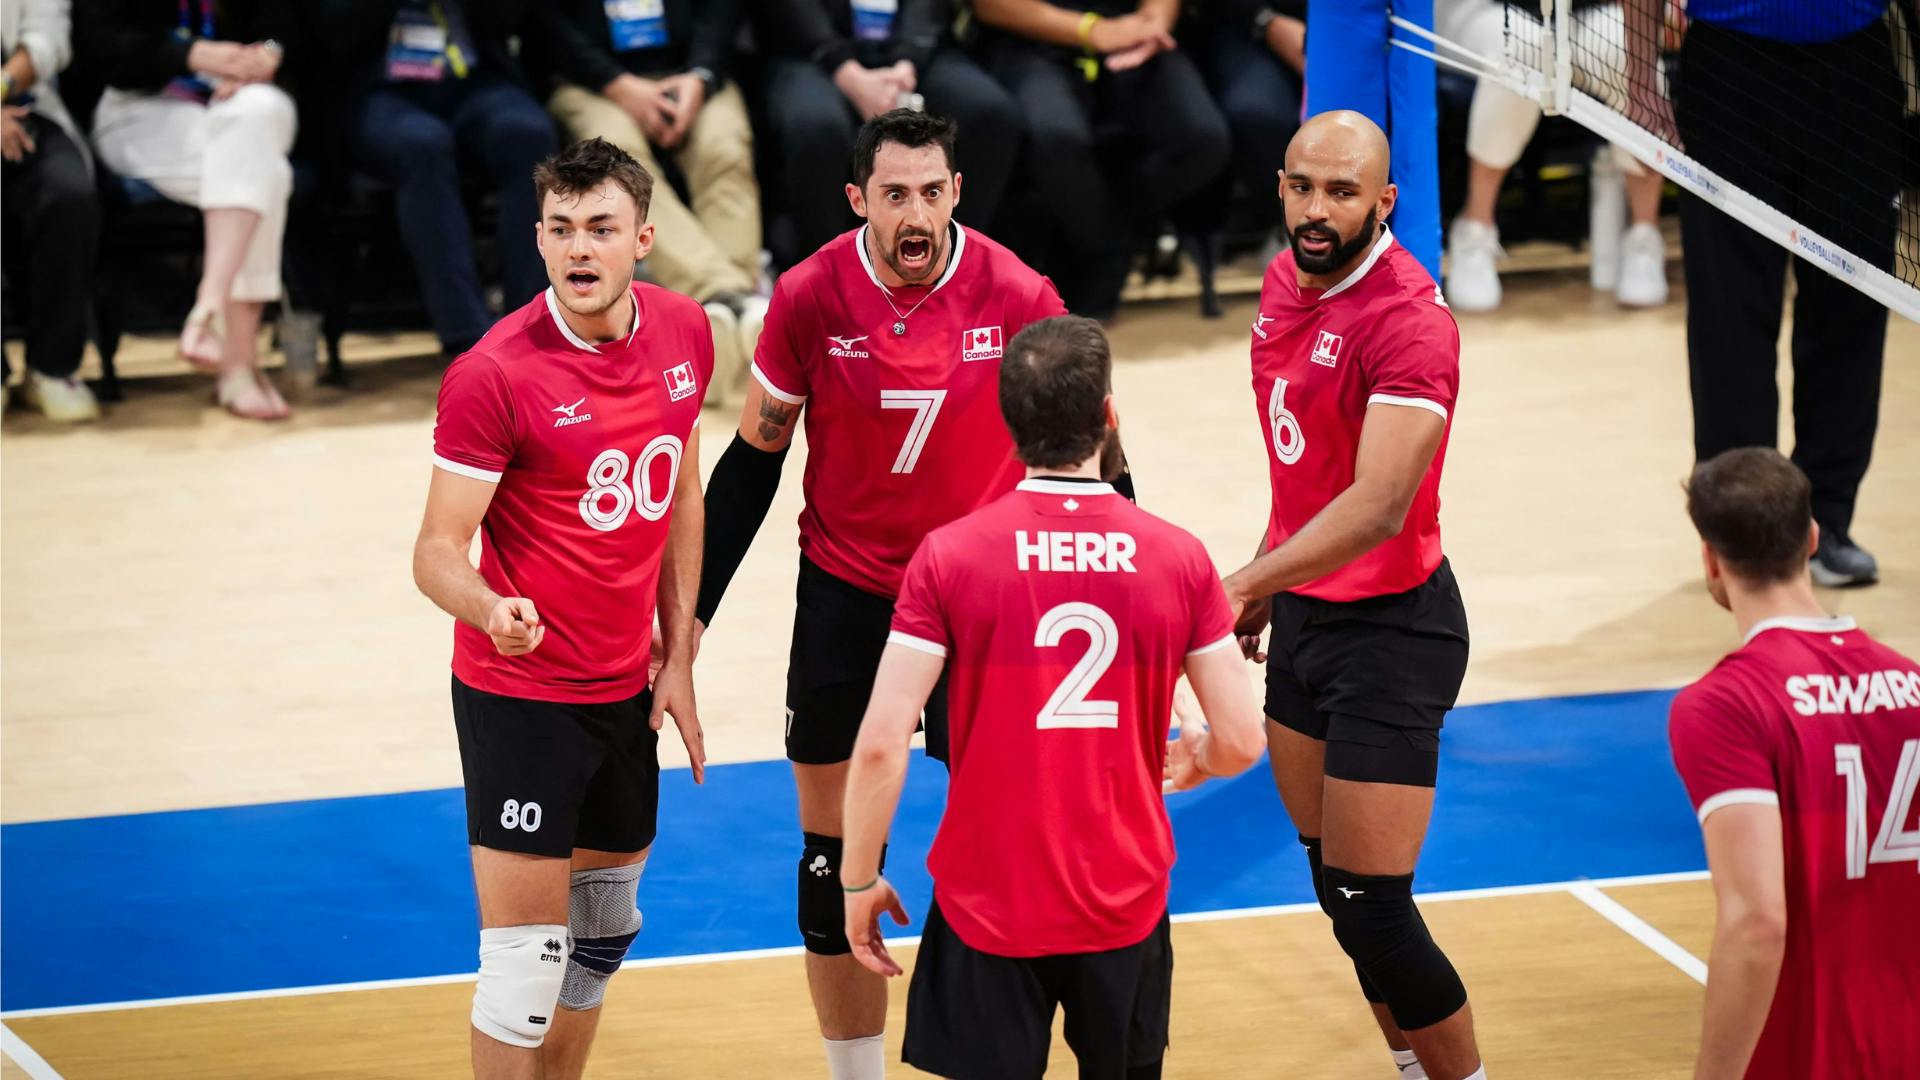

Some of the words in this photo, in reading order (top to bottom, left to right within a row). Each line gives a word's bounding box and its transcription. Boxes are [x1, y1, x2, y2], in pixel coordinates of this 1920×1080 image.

[671, 384, 696, 400] Canada
[964, 349, 1001, 359] Canada
[880, 389, 948, 474] 7
[1269, 376, 1306, 465] 6
[578, 434, 684, 532] 80
[1015, 530, 1138, 573] HERR
[1033, 601, 1119, 730] 2
[500, 798, 542, 833] 80
[1834, 738, 1920, 880] 14
